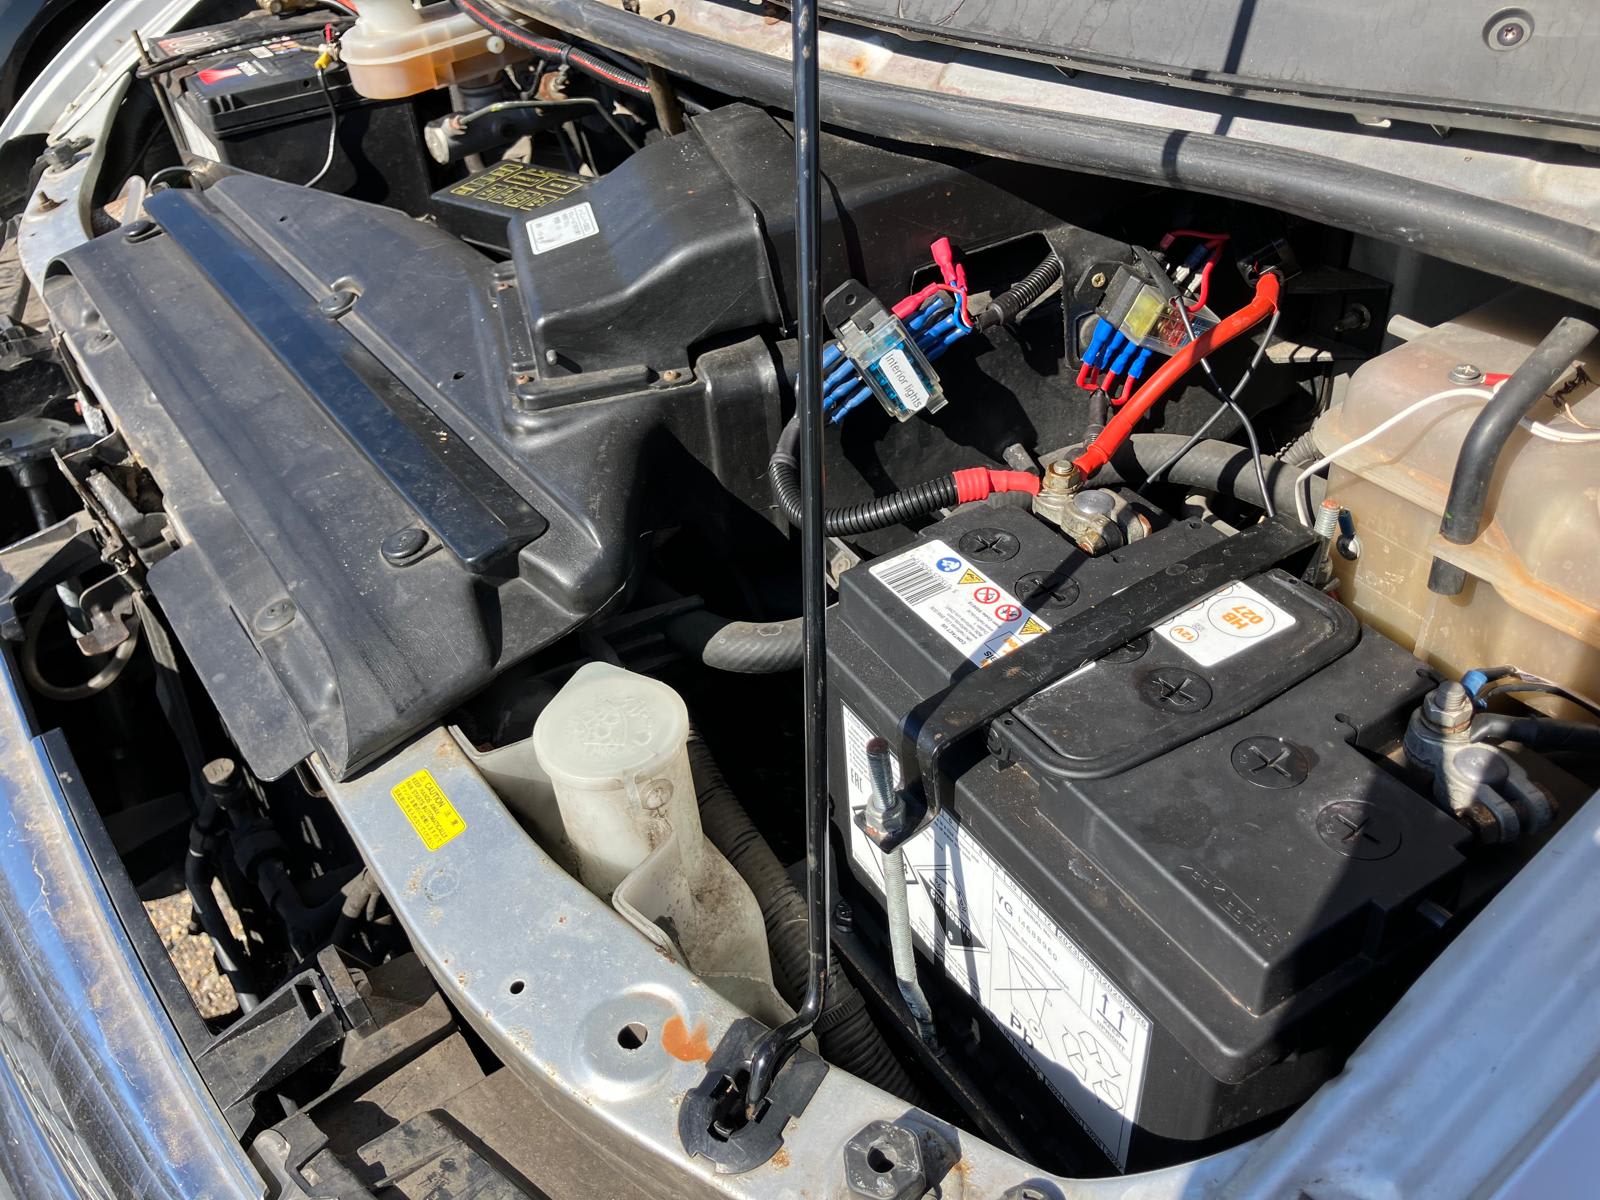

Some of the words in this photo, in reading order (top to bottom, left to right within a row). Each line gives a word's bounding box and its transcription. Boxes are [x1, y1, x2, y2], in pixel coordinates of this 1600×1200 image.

[886, 354, 908, 385] Interior
[904, 382, 922, 408] lights
[1222, 612, 1250, 630] HB
[1232, 606, 1264, 625] 027
[945, 627, 967, 645] CONTACT
[1175, 627, 1194, 641] 12V
[423, 781, 445, 808] CAUTION
[421, 804, 448, 839] AUTOMATICALLY
[930, 886, 971, 941] CORROSIVE
[995, 888, 1013, 919] YG
[1009, 1010, 1035, 1052] Pb
[1102, 1017, 1121, 1041] KEEP
